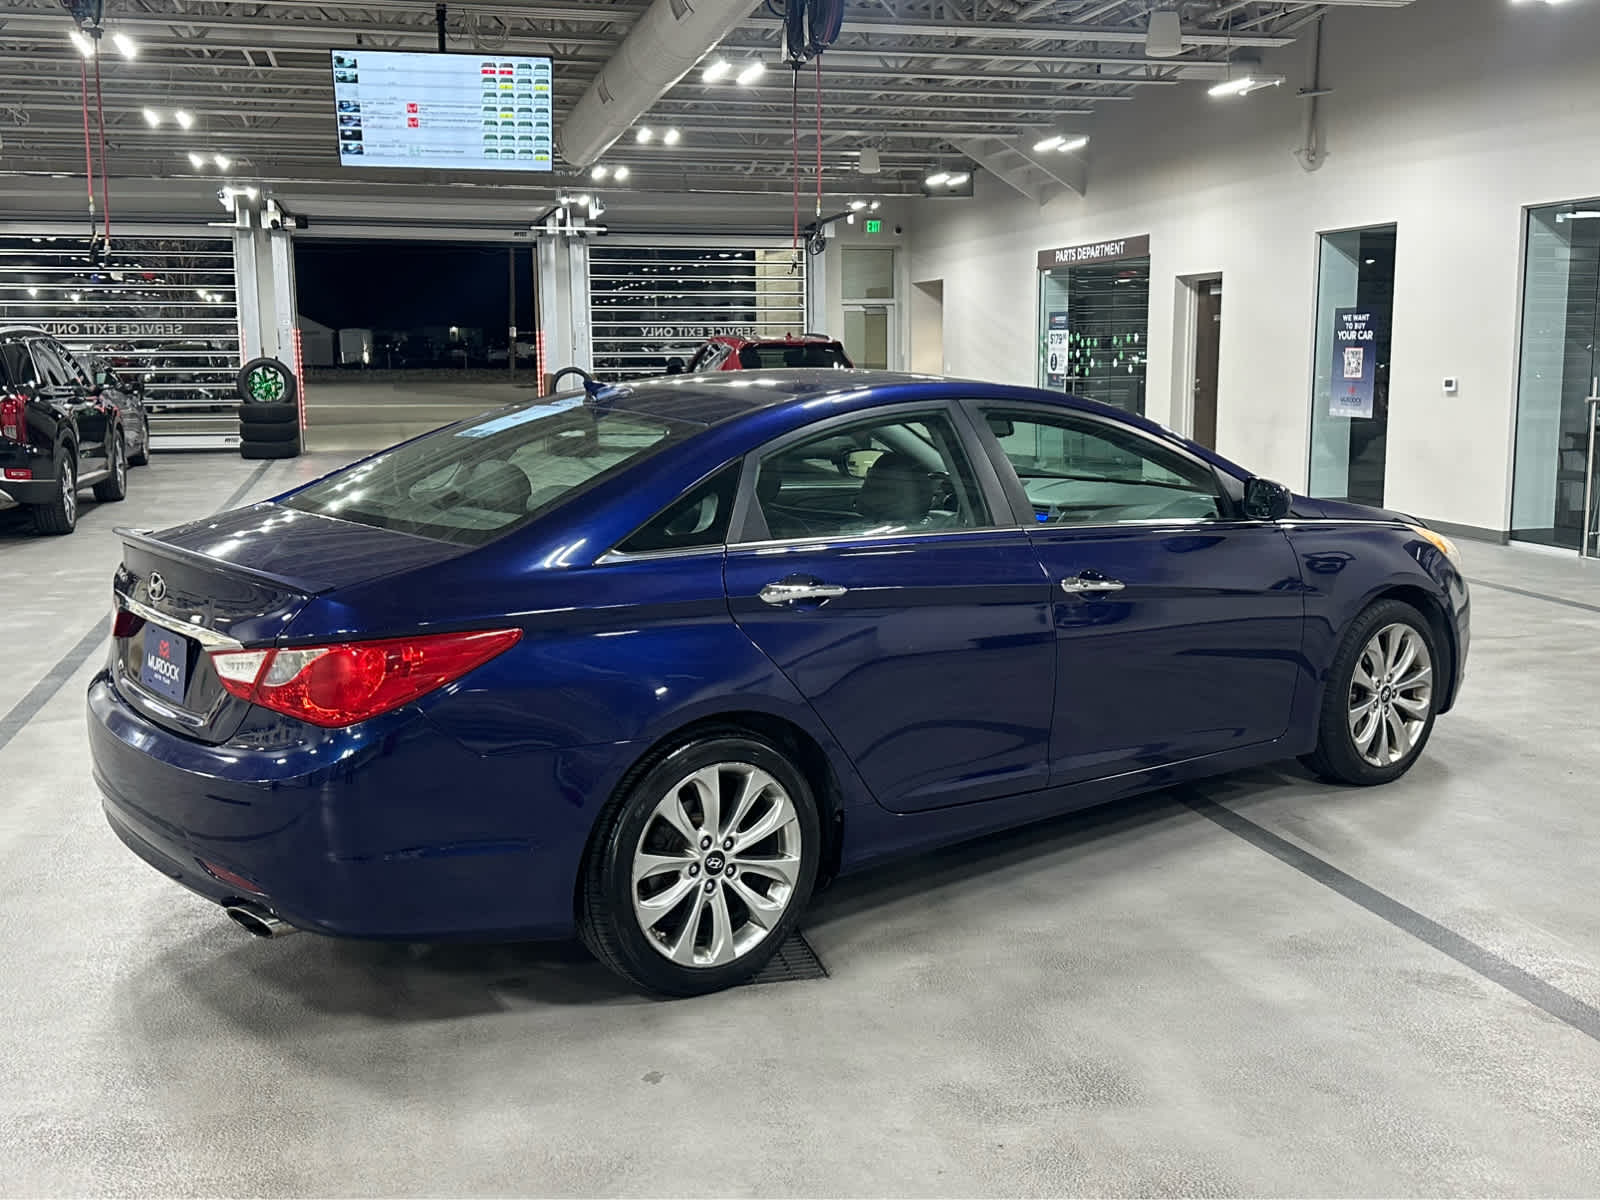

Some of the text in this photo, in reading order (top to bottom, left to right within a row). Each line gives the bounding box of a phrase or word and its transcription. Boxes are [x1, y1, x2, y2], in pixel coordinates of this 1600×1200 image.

[1055, 241, 1125, 263] PARTS DEPARTMENT
[1353, 313, 1370, 321] WANT
[1337, 330, 1374, 340] YOUR CAR
[147, 653, 180, 682] MURDOCK
